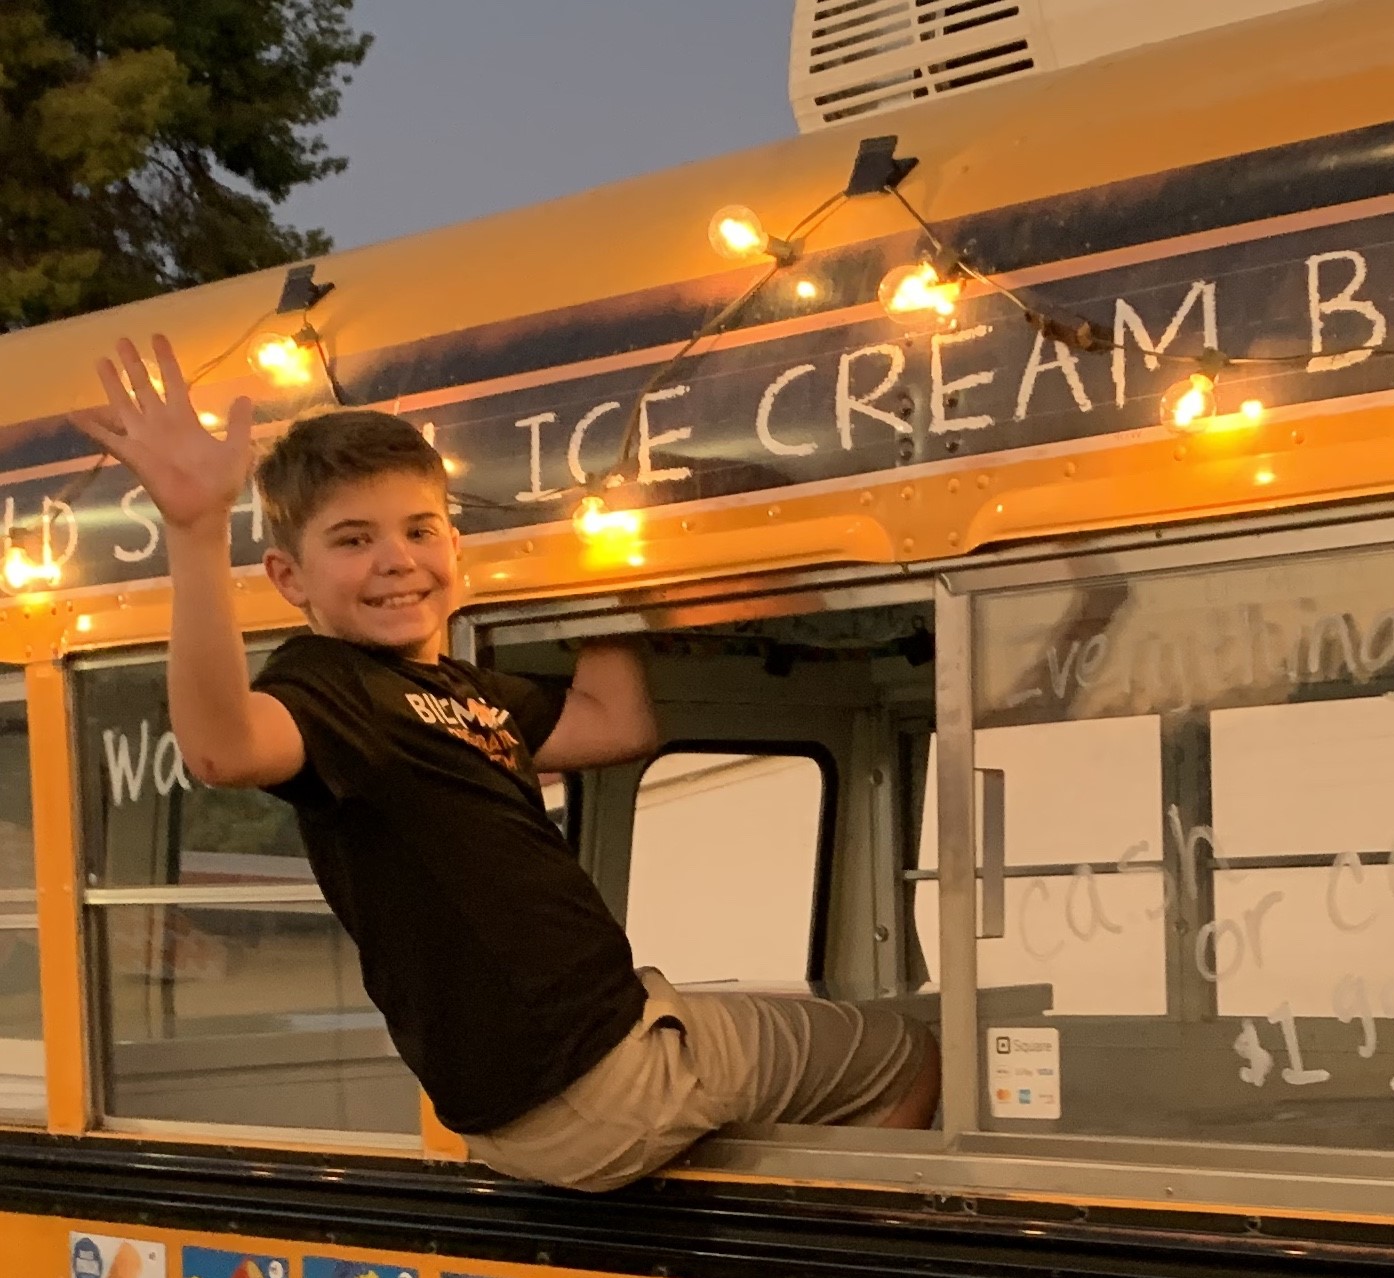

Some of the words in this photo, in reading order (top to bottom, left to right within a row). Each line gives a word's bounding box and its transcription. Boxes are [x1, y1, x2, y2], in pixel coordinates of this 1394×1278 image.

[515, 385, 693, 502] ICE
[755, 281, 1218, 456] CREAM
[103, 719, 194, 806] Wa
[1018, 803, 1246, 961] cash
[1196, 890, 1285, 981] or
